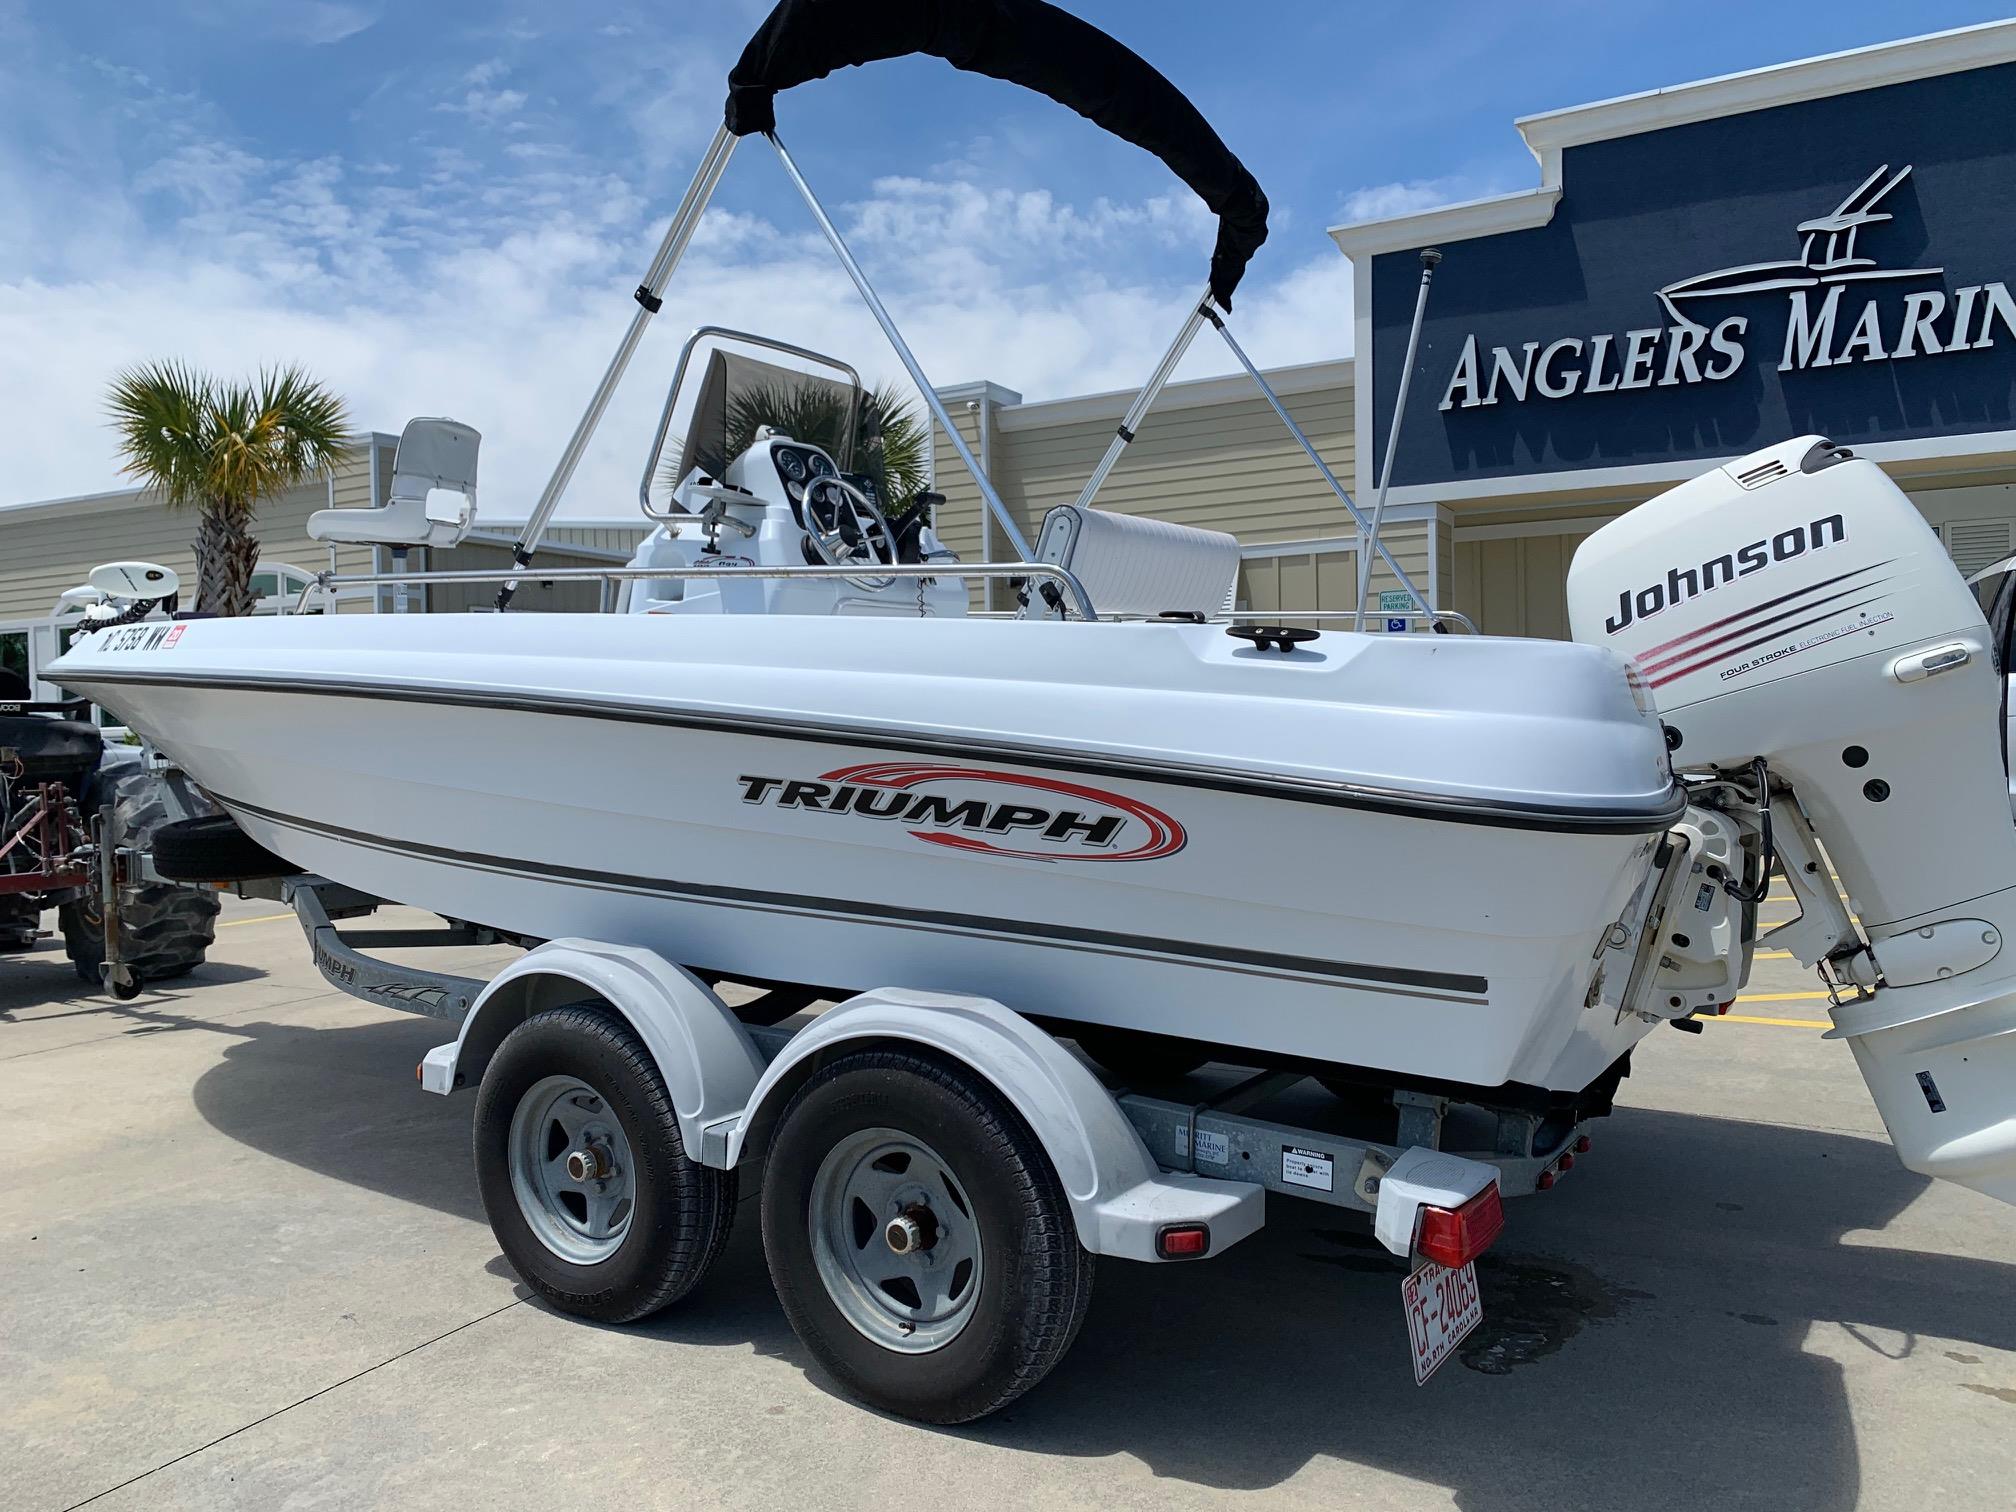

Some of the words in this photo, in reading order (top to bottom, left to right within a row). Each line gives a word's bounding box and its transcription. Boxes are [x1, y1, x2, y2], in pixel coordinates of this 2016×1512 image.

[1438, 317, 1748, 411] ANGLERS
[1382, 594, 1411, 603] RESERVED
[1605, 513, 1846, 635] Johnson
[1384, 602, 1409, 610] PARKING
[1719, 664, 1750, 679] FOUR
[1751, 645, 1797, 667] STROKE
[1799, 629, 1840, 648] ELECTRONIC
[1841, 623, 1857, 634] FUEL
[1859, 611, 1894, 628] INJECTION
[737, 774, 1127, 847] TRIUMPH
[1297, 1148, 1325, 1159] WARNING
[1420, 1344, 1445, 1374] NORTH
